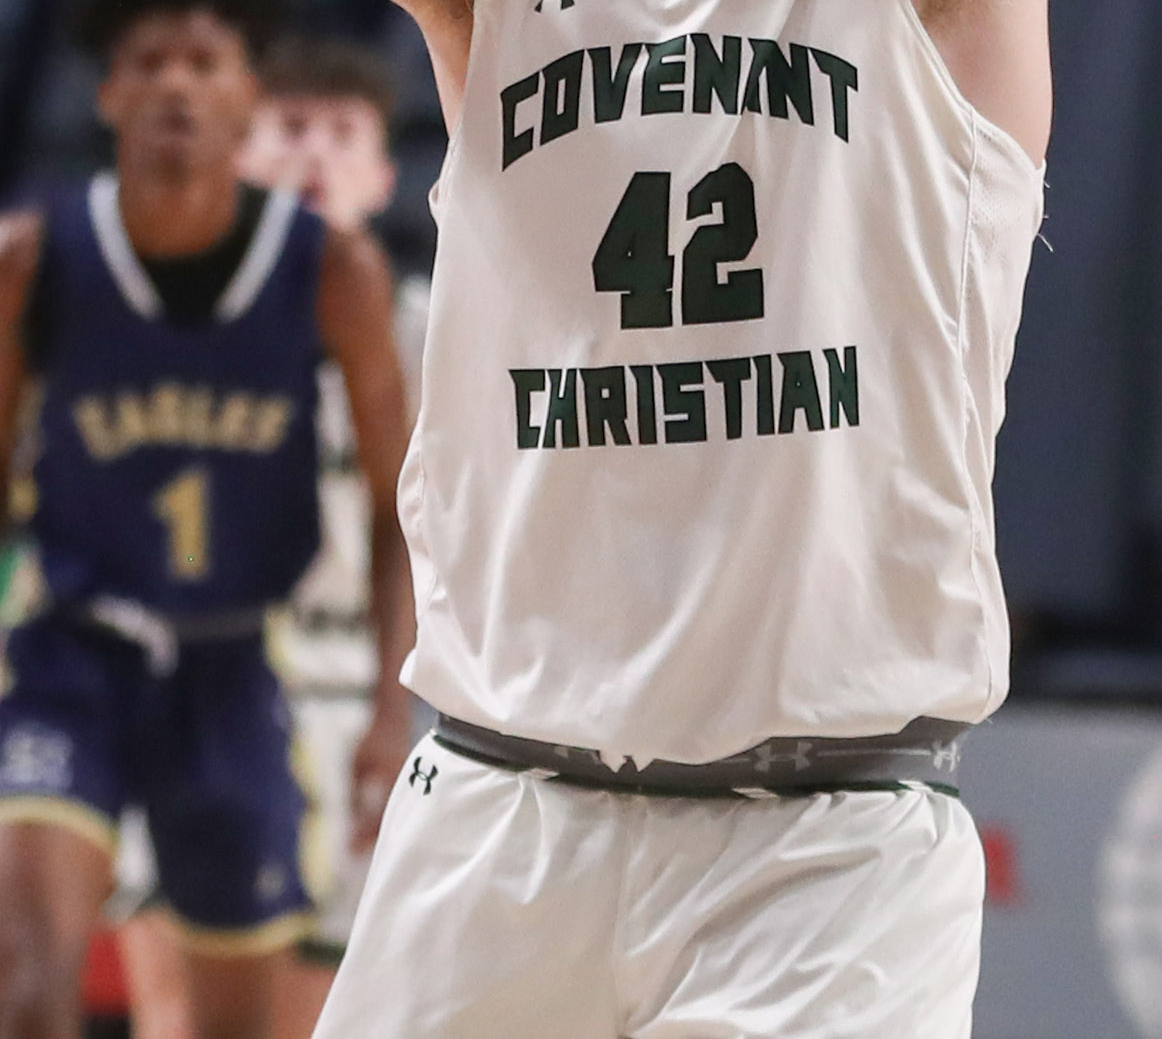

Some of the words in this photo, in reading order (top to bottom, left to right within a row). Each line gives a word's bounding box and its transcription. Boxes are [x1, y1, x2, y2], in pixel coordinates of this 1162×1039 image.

[500, 32, 859, 173] COVENANT
[591, 162, 765, 330] 42
[508, 345, 860, 450] CHRISTIAN
[152, 465, 212, 581] 1
